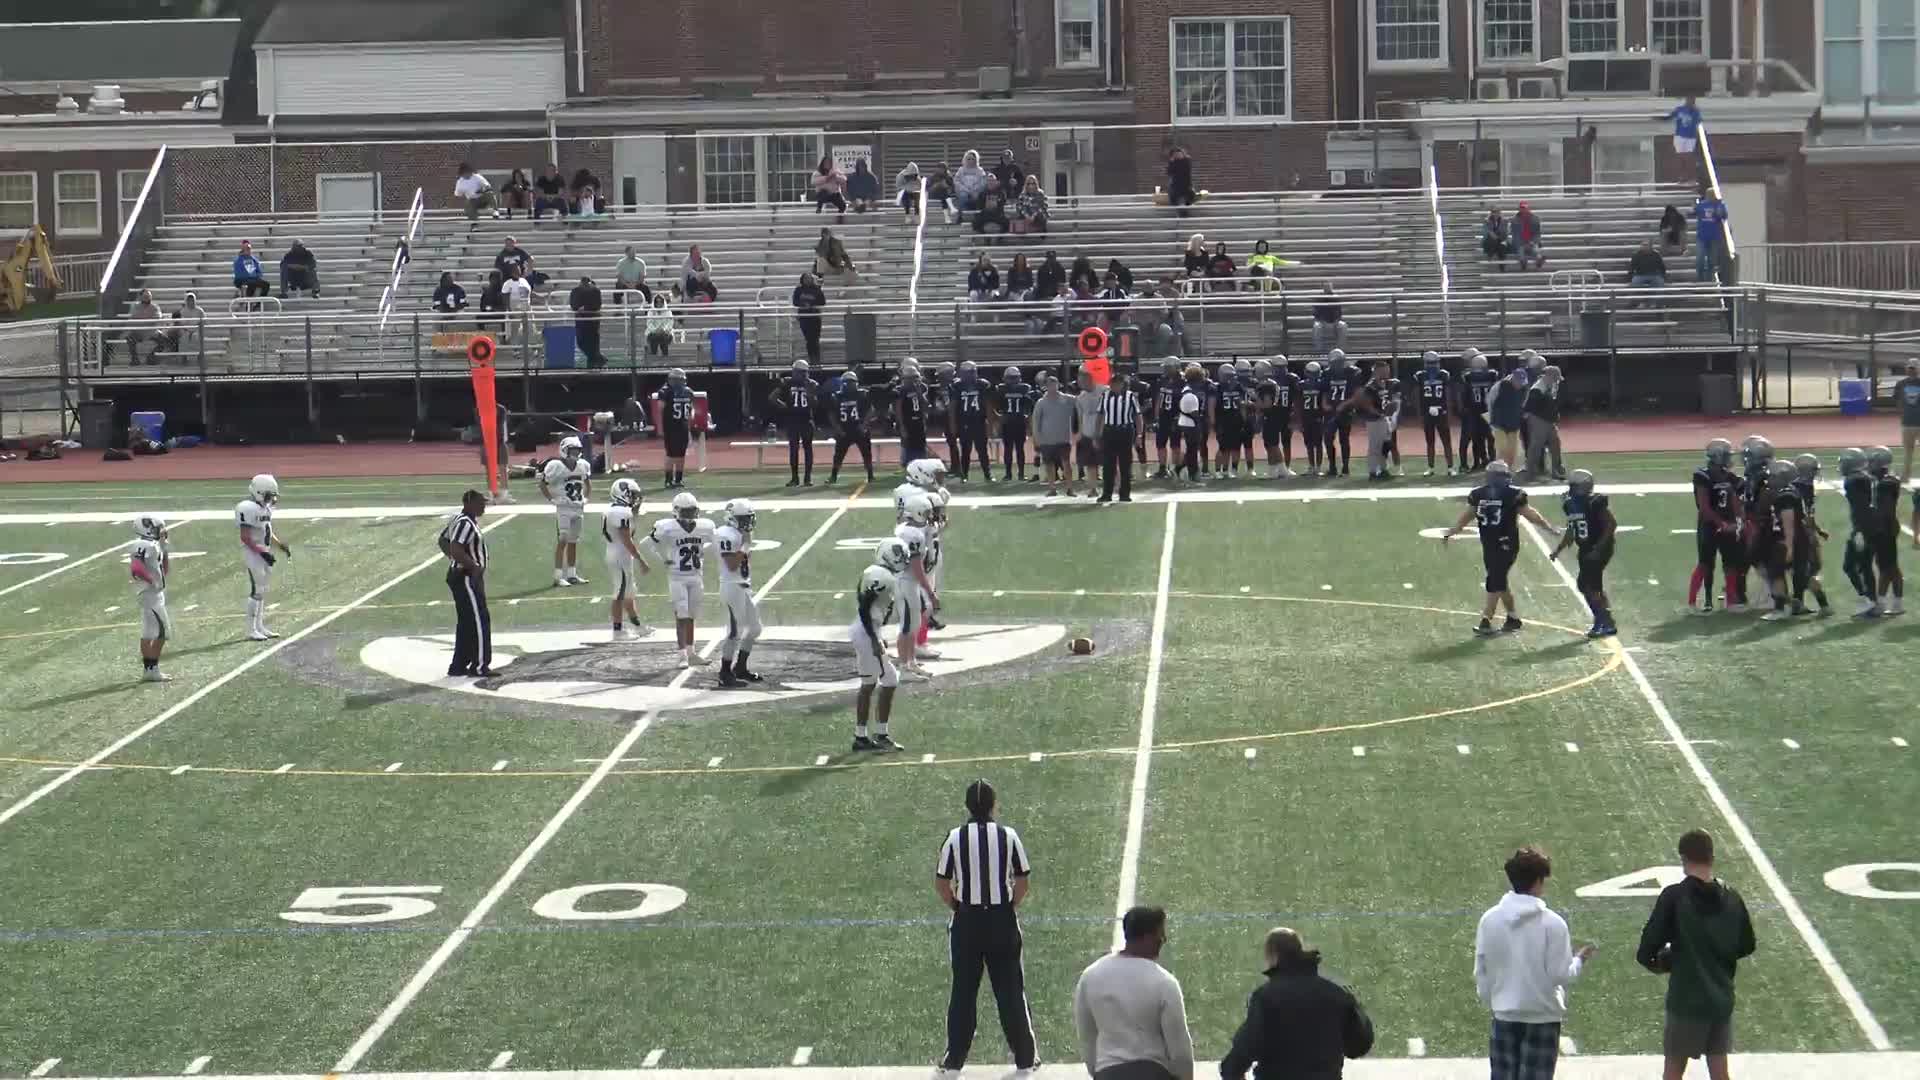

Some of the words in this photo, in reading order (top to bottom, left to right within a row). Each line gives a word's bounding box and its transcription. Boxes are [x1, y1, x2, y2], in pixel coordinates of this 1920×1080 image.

[791, 391, 808, 408] 76
[961, 395, 980, 412] 74
[1007, 398, 1020, 413] 11
[1304, 395, 1319, 410] 21
[839, 406, 860, 422] 54
[1476, 504, 1502, 527] 53
